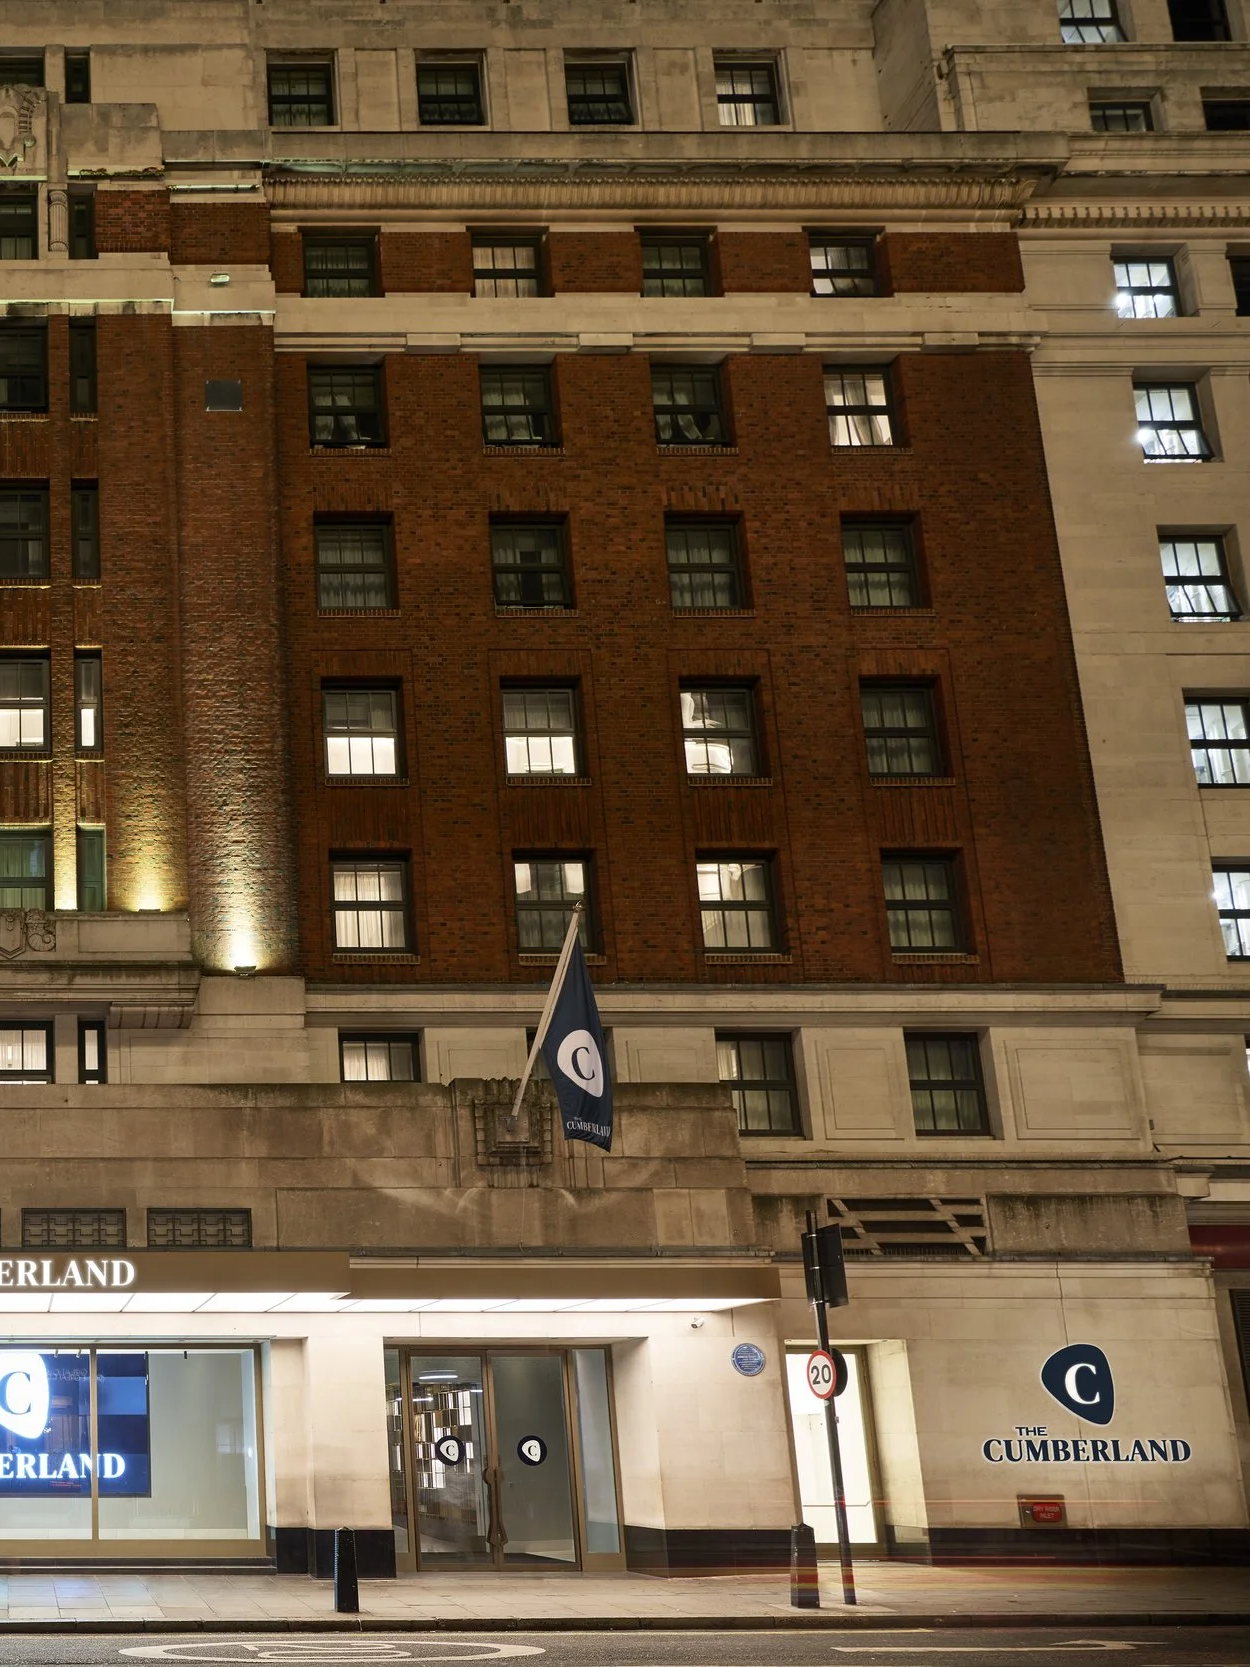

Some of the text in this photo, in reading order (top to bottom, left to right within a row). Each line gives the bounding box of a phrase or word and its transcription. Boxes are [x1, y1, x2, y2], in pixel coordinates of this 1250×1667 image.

[571, 1047, 595, 1080] C
[811, 1364, 831, 1385] 20
[1065, 1363, 1101, 1405] C
[1015, 1427, 1047, 1436] THE
[446, 1445, 455, 1456] C
[528, 1445, 537, 1456] C
[983, 1439, 1191, 1462] CUMBERLAND
